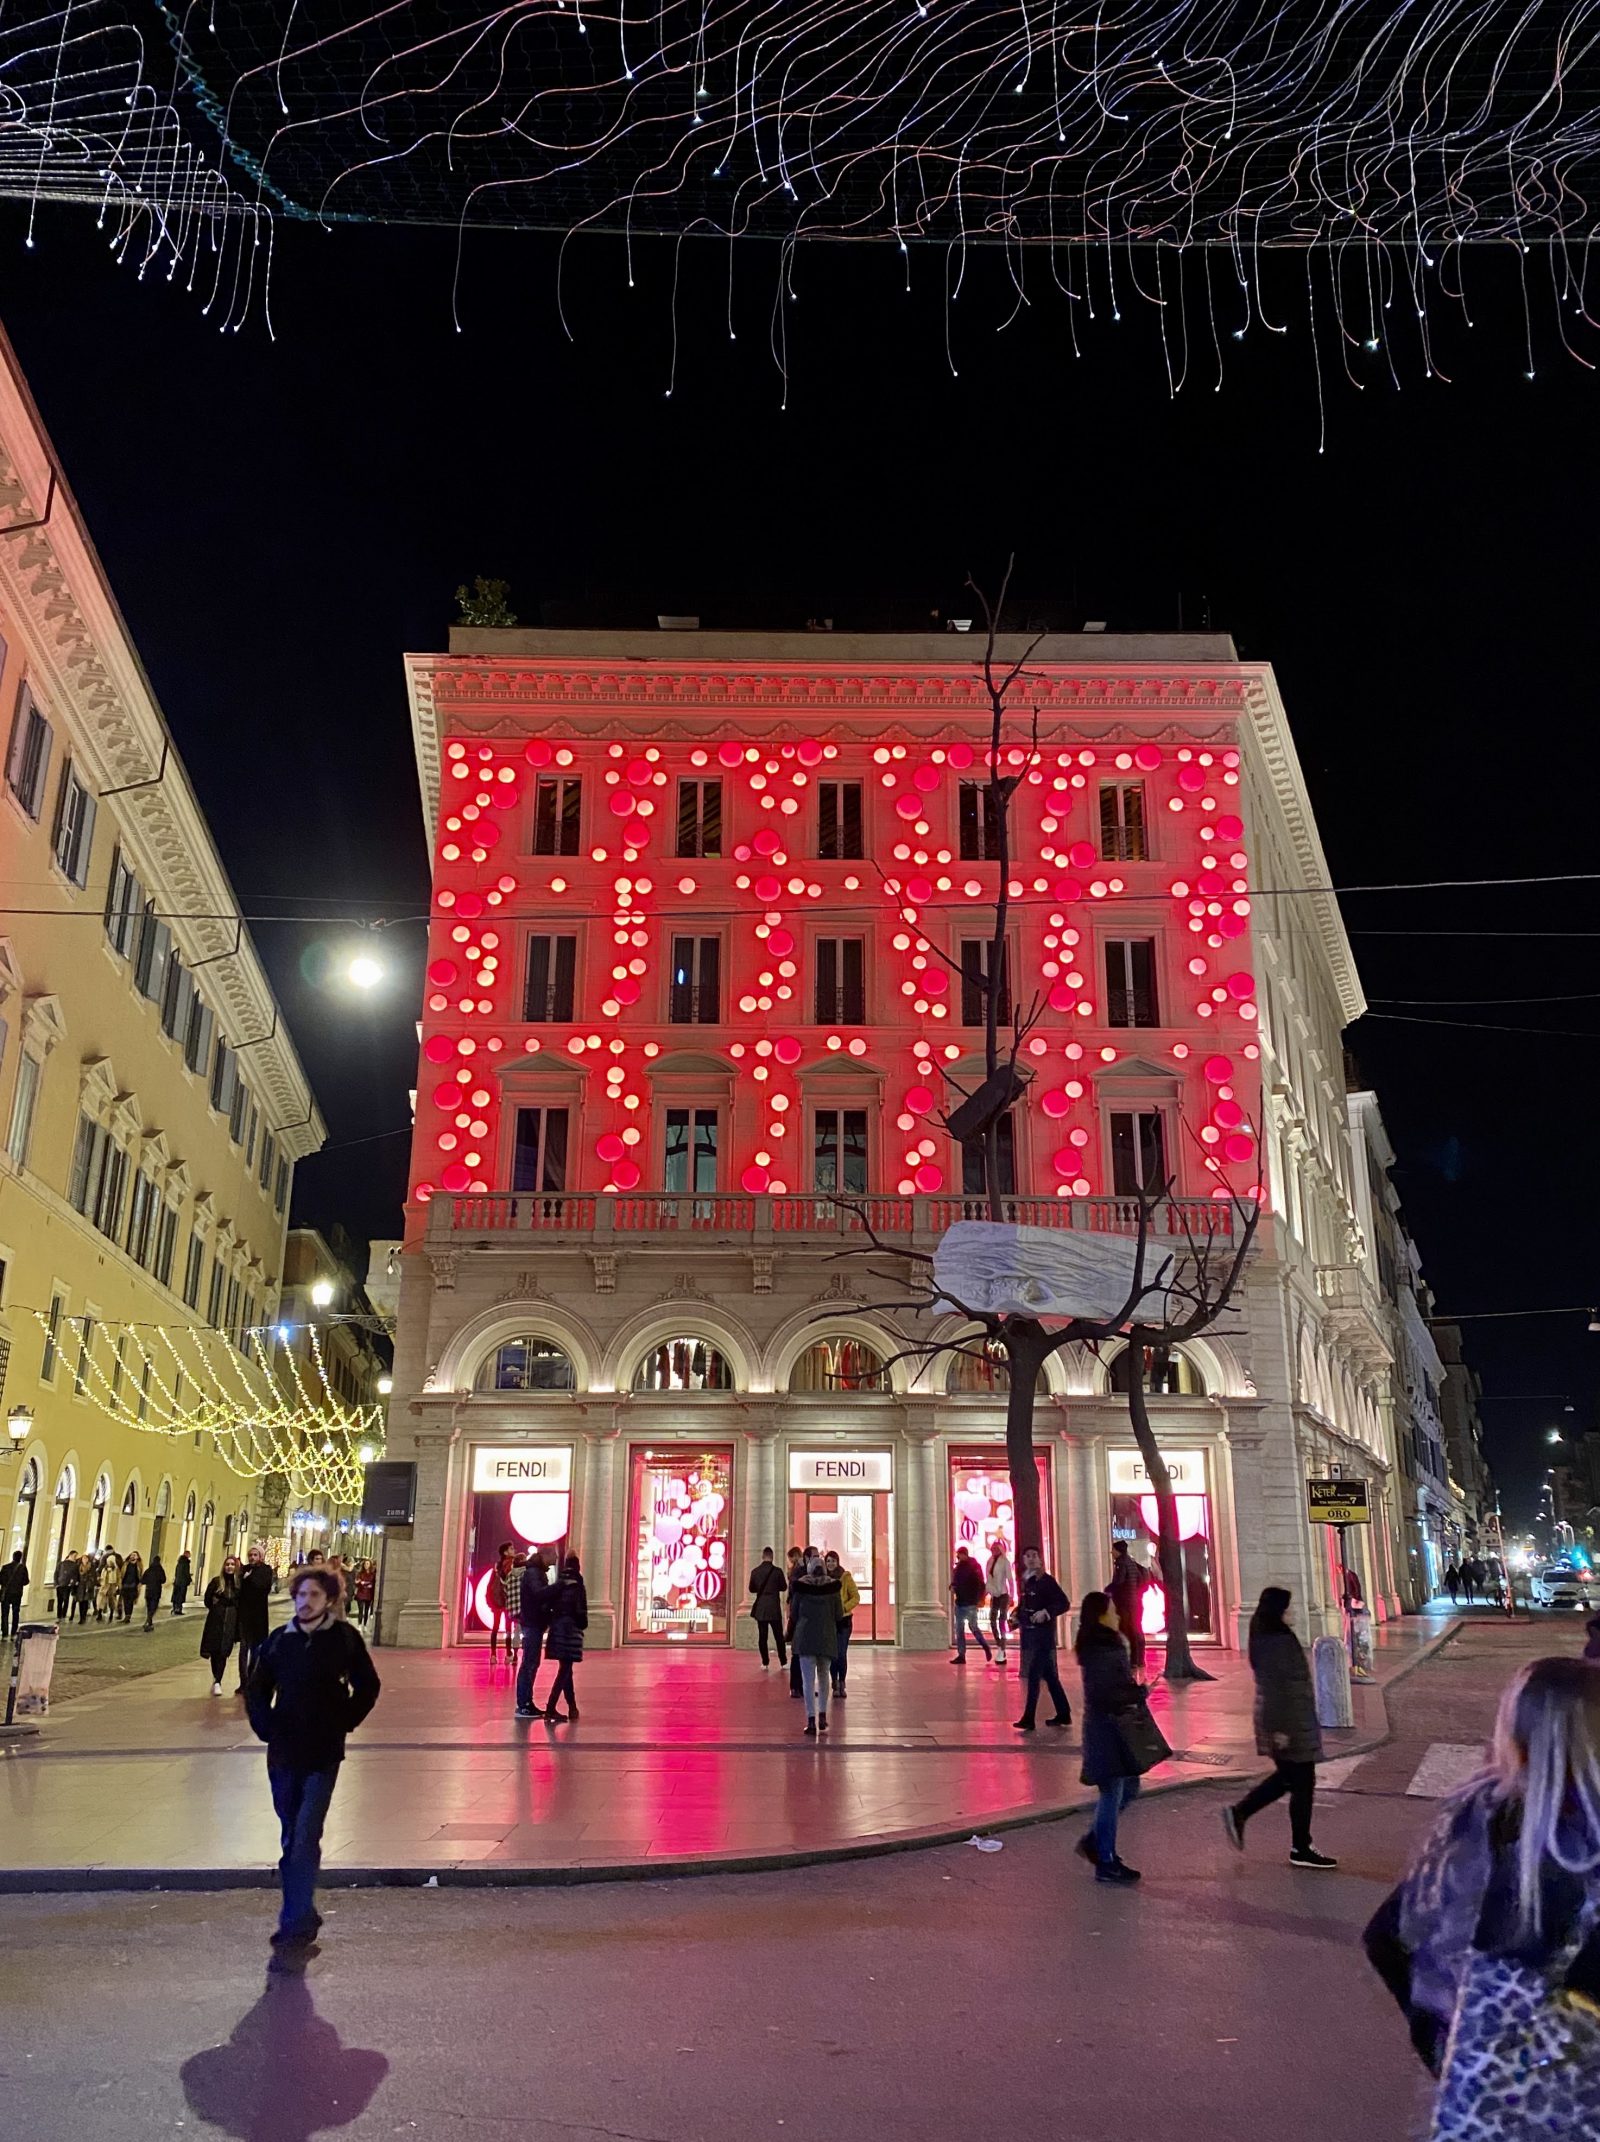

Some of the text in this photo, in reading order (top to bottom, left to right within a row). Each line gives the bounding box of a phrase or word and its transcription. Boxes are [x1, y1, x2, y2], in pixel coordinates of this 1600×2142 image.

[496, 1462, 546, 1477] FENDI
[815, 1461, 865, 1477] FENDI
[1133, 1464, 1183, 1480] FDI
[1327, 1510, 1351, 1518] ORO
